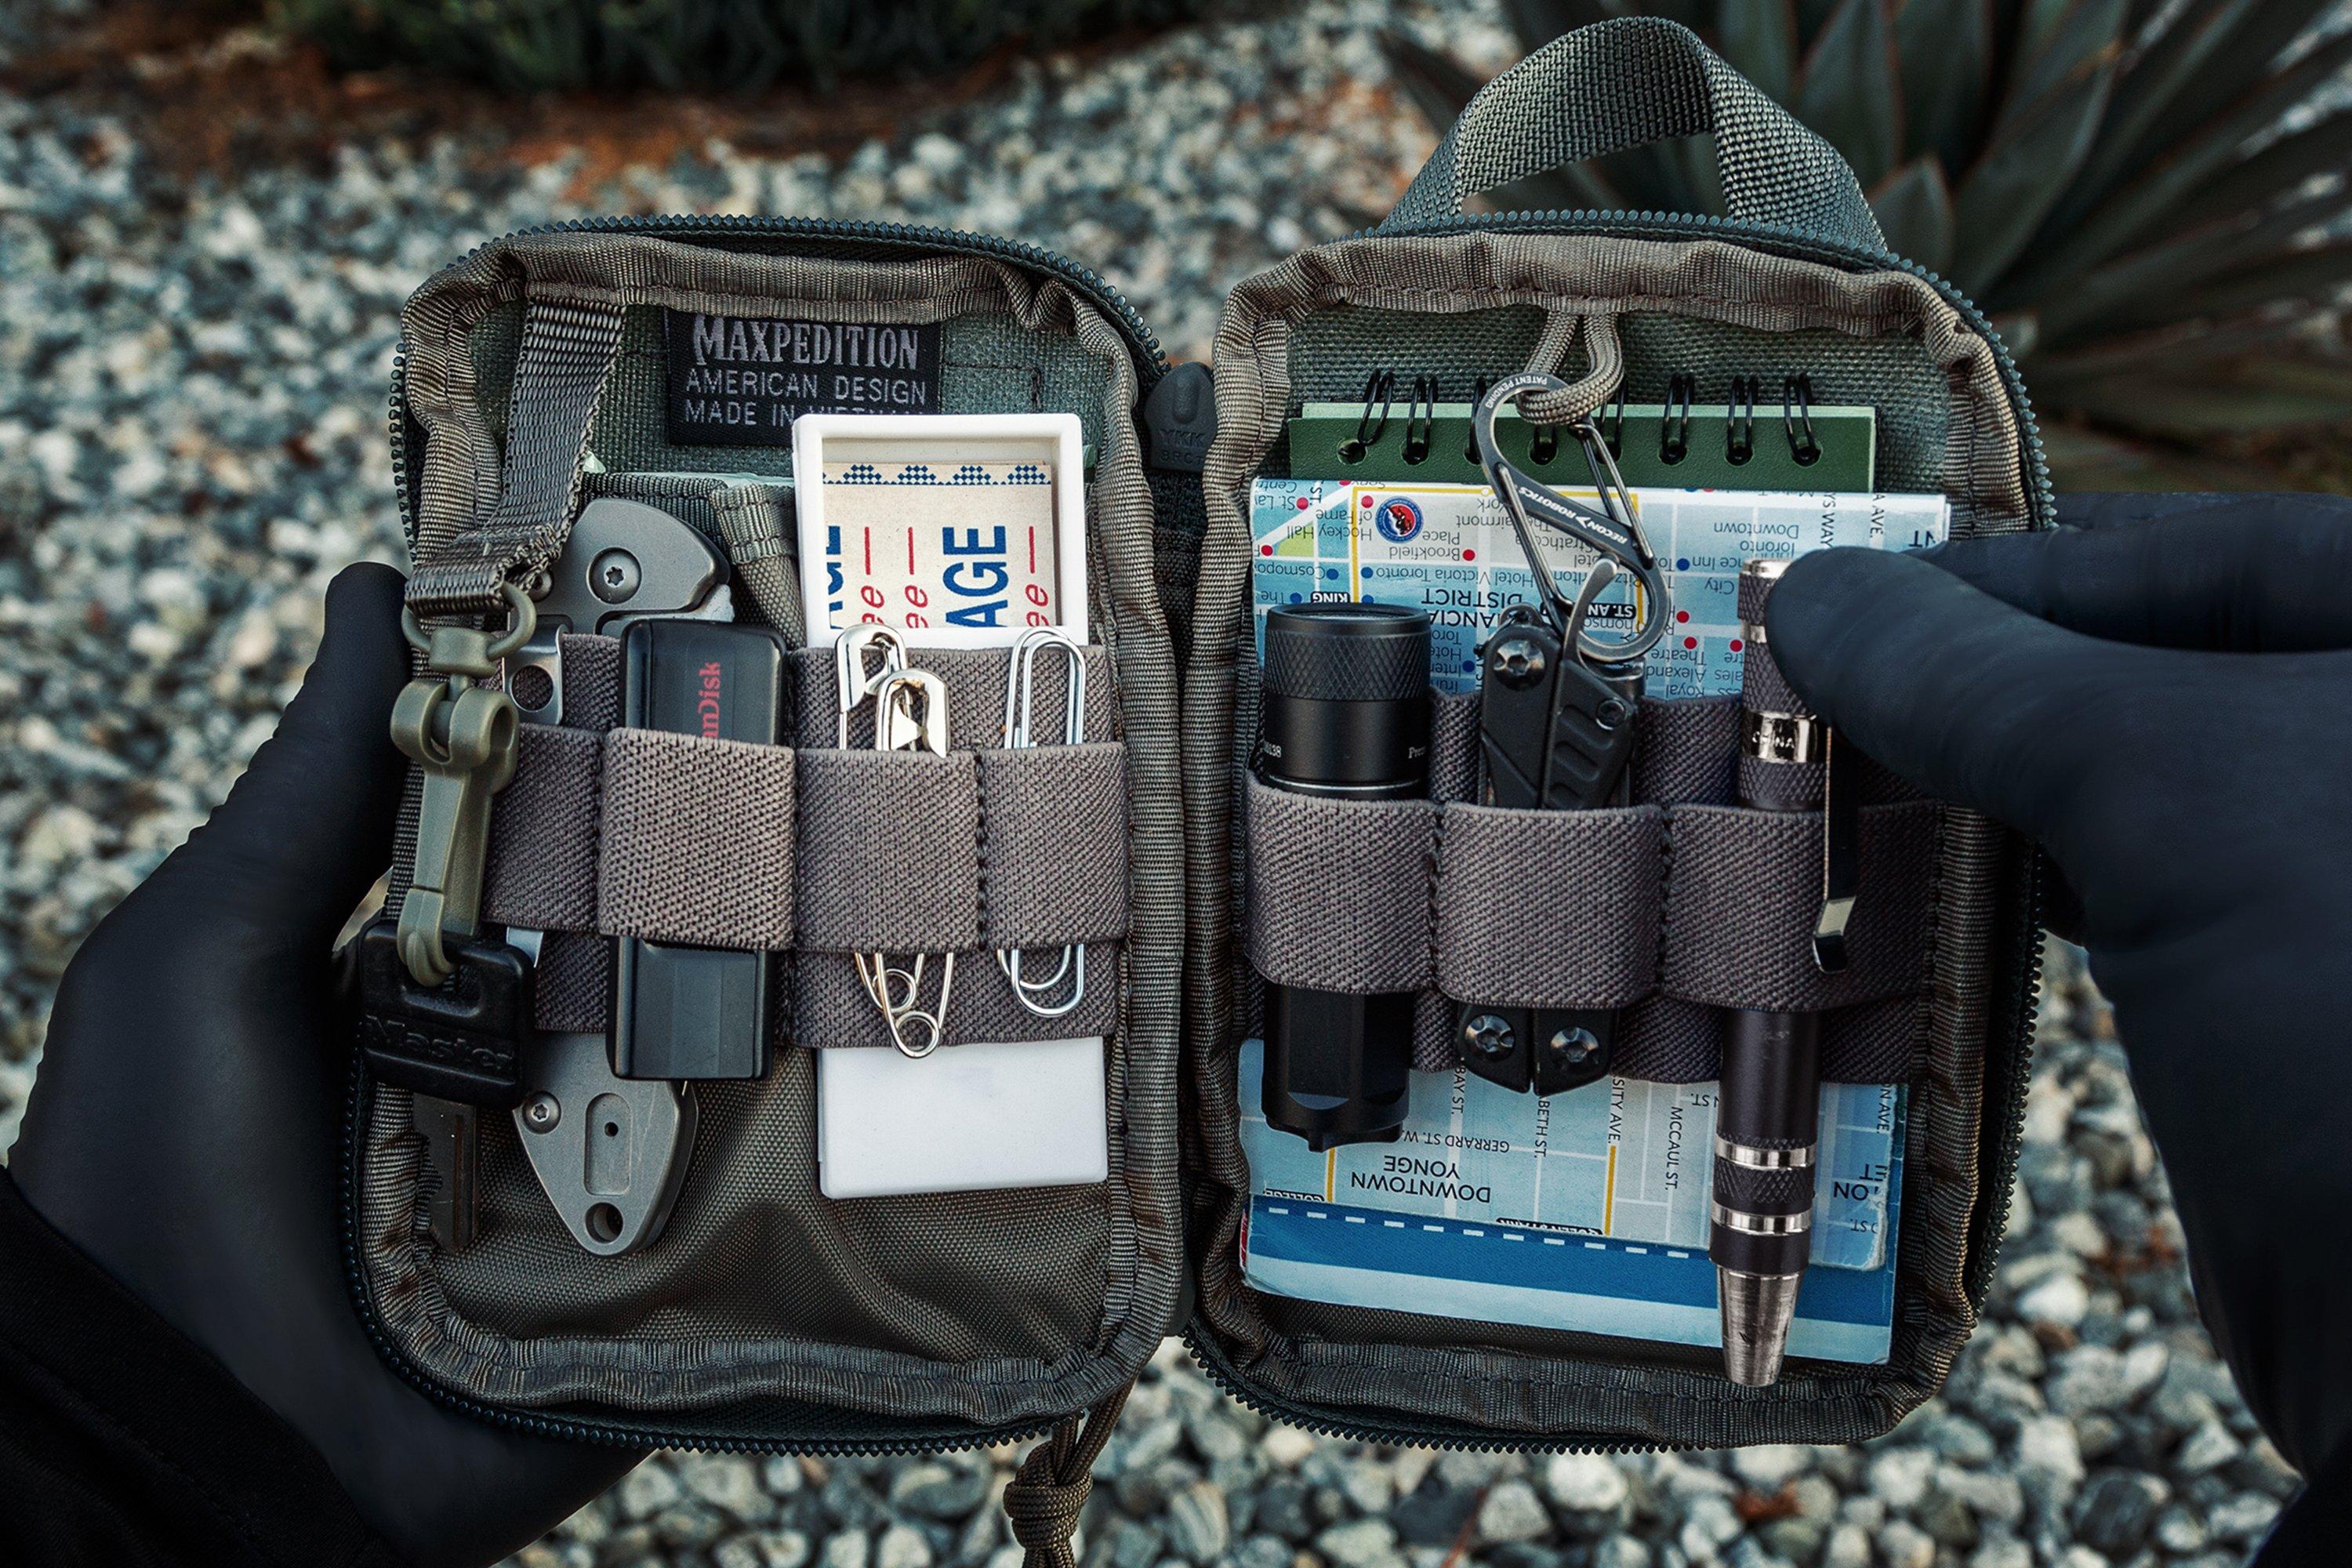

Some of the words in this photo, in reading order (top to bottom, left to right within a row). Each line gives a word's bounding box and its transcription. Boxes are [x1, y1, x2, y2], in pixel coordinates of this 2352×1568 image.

[691, 314, 919, 370] MAXPEDITION
[685, 367, 818, 399] AMERICAN
[835, 374, 927, 405] DESIGN
[1514, 376, 1548, 386] PATENT
[1485, 379, 1515, 408] PENDING
[683, 399, 757, 426] MADE
[772, 405, 795, 426] IN
[1255, 481, 1298, 492] Centr
[1254, 495, 1275, 510] La
[1517, 486, 1578, 518] ROBOTICS
[1315, 510, 1354, 524] Fame
[1359, 510, 1374, 524] of
[1456, 514, 1514, 529] airmont
[1869, 506, 1886, 539] AVE.
[1287, 525, 1315, 539] Hall
[1319, 524, 1372, 540] Hockey
[1422, 530, 1461, 545] Place
[1589, 520, 1628, 545] RECON
[1714, 522, 1799, 539] Downtown
[1820, 511, 1835, 548] WAY
[1515, 534, 1593, 554] Strathcoa
[1740, 540, 1795, 556] Toronto
[1389, 546, 1461, 561] Brookfield
[1575, 554, 1601, 568] otel
[1692, 557, 1716, 568] Inn
[1377, 567, 1429, 583] Toronto
[1435, 569, 1491, 585] Victoria
[1494, 570, 1534, 587] Hotel
[1704, 578, 1736, 595] City
[1261, 591, 1285, 604] The
[1312, 593, 1348, 604] KING
[1421, 588, 1523, 610] DISTRICT
[1430, 609, 1501, 629] ANCIA
[1615, 604, 1634, 618] ST.
[1432, 630, 1461, 645] Toro
[1651, 649, 1706, 666] Theatre
[1430, 680, 1459, 694] Tru
[1666, 684, 1704, 699] Royal
[698, 662, 720, 738] nDisk
[1454, 1067, 1467, 1093] BAY
[1450, 1096, 1465, 1115] ST.
[1690, 1092, 1710, 1107] ST.
[1536, 1098, 1552, 1137] BETH
[1876, 1102, 1891, 1134] AVE.
[1401, 1129, 1419, 1142] W.
[1607, 1112, 1624, 1144] AVE.
[1424, 1131, 1442, 1145] ST.
[1444, 1134, 1511, 1154] GERRARD
[1667, 1106, 1684, 1168] MCCAUL
[1534, 1140, 1548, 1159] ST.
[1383, 1155, 1461, 1180] YONGE
[1351, 1171, 1491, 1203] DOWNTOWN
[1664, 1171, 1679, 1191] ST.
[1833, 1181, 1878, 1202] ON
[1849, 1218, 1868, 1233] ST.
